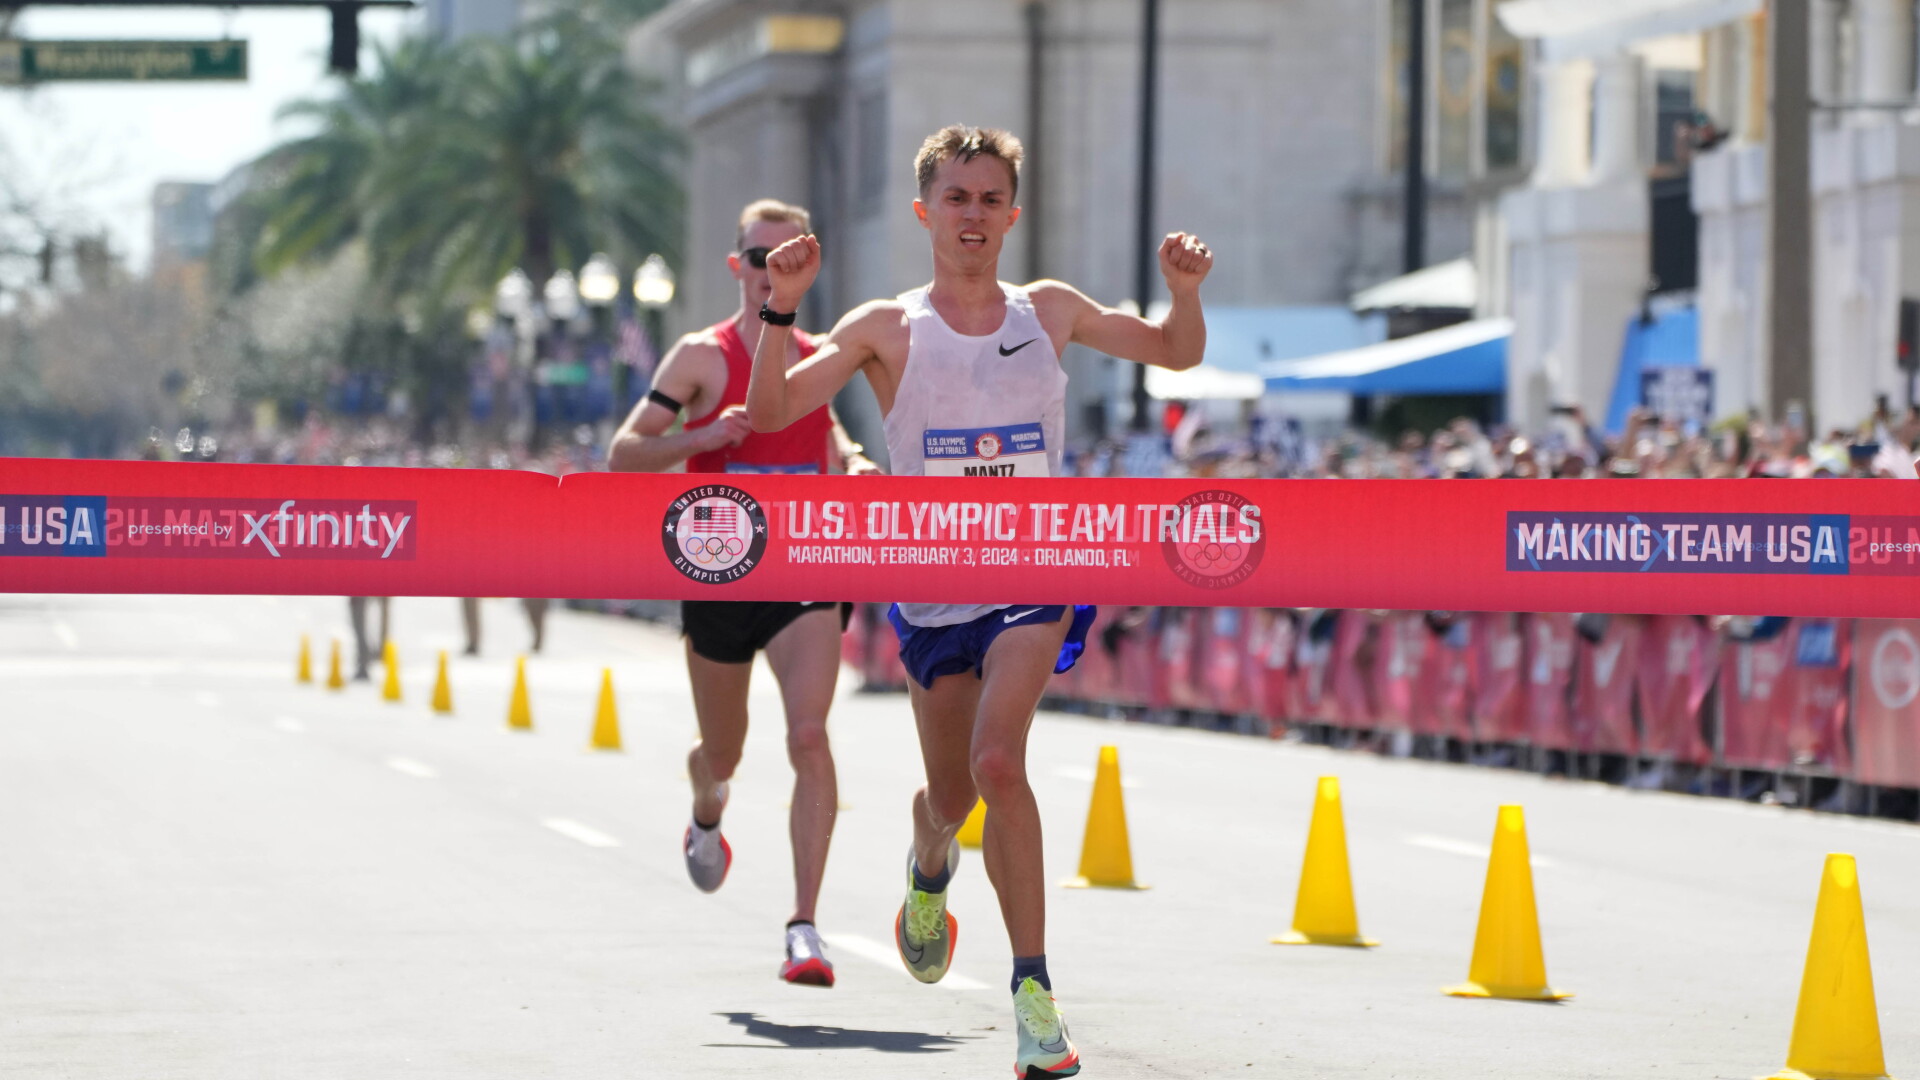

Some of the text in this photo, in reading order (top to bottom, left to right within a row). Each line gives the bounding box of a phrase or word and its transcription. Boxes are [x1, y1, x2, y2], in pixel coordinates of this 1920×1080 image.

[926, 437, 966, 447] U.S. OLYMPIC
[1011, 432, 1040, 443] MARATHON
[926, 446, 967, 455] TEAM TRIALS
[674, 487, 757, 512] UNITED STATES
[21, 506, 94, 546] USA
[128, 522, 208, 538] presented
[213, 522, 233, 539] by
[241, 500, 411, 559] xfinity
[788, 501, 1261, 543] U.S. OLYMPIC TEAM TRIALS
[1517, 522, 1651, 562] MAKING
[1661, 523, 1752, 562] TEAM
[1766, 525, 1837, 563] USA
[674, 556, 754, 582] OLYMPIC TEAM
[788, 545, 1131, 568] MARATHON, FEBRUARY 3, 2024 ORLANDO, FL
